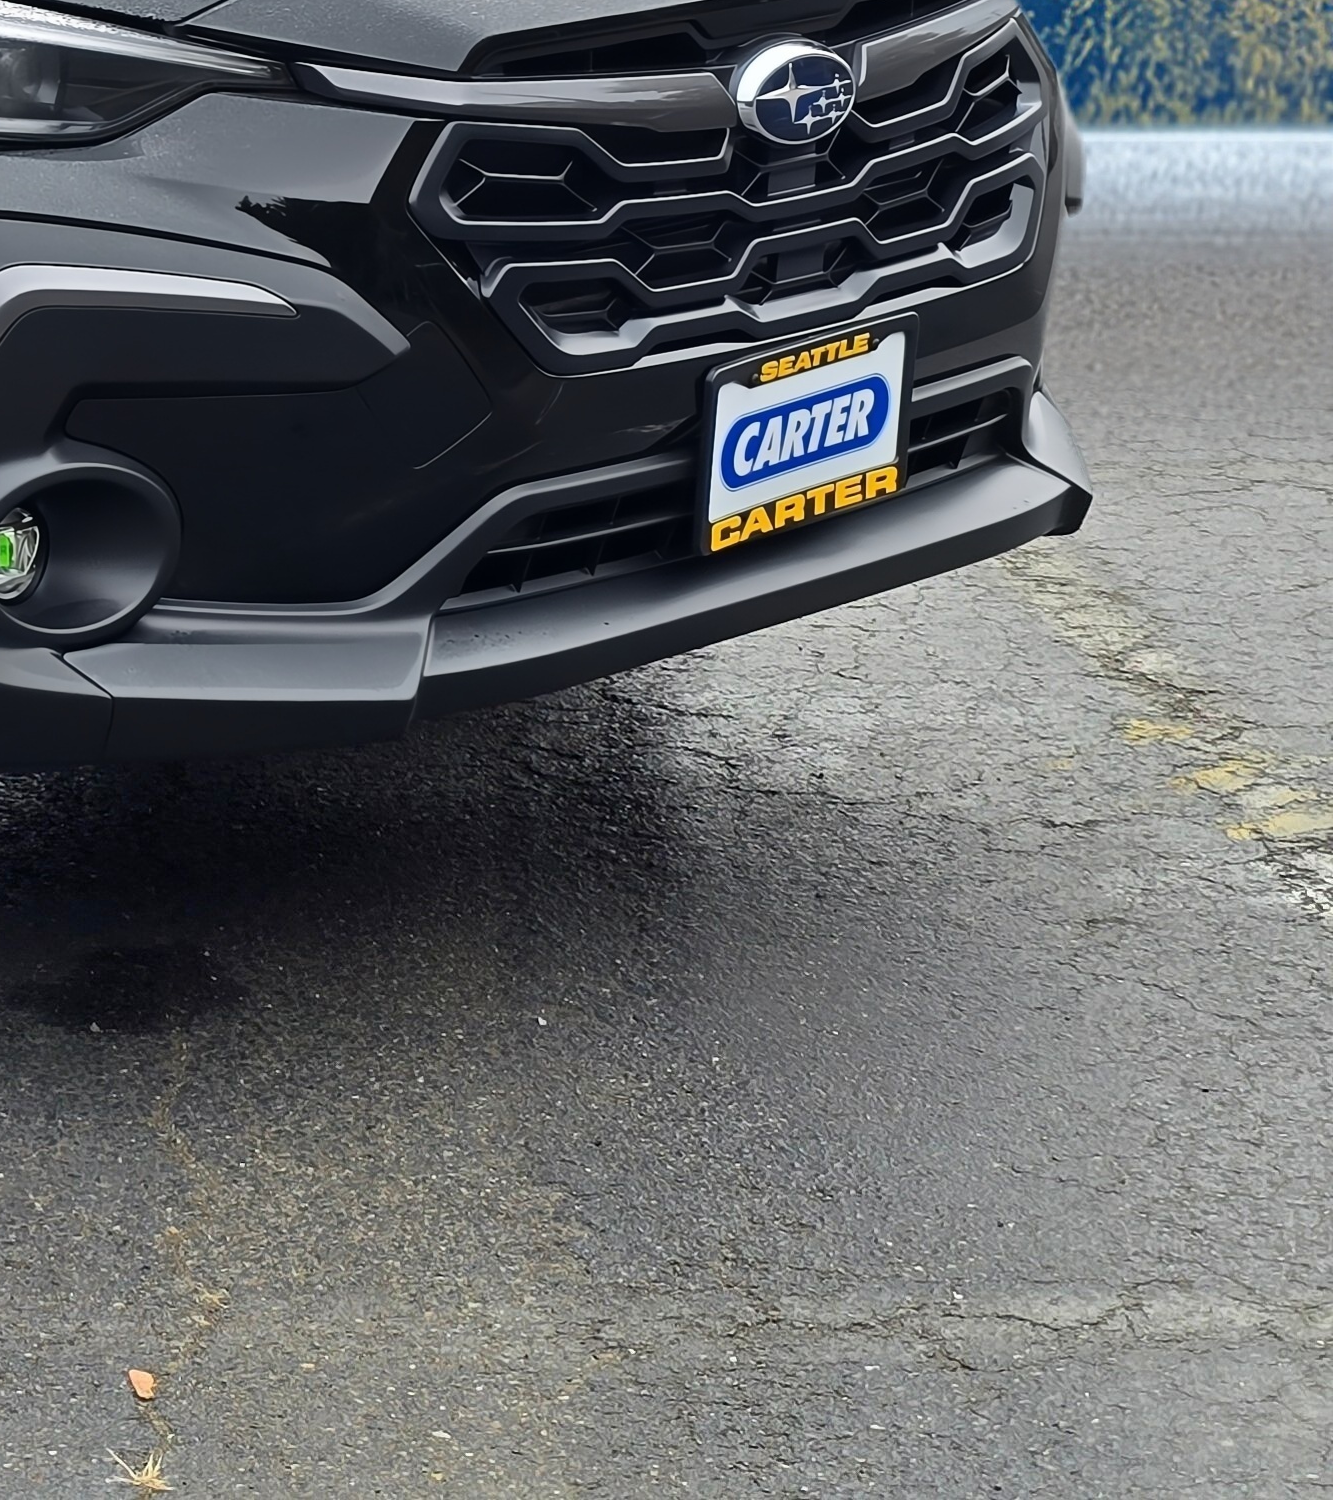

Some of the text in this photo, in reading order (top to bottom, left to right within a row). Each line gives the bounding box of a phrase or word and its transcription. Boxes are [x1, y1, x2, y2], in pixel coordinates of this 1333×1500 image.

[759, 332, 871, 383] SEATTLE
[733, 388, 875, 477] CARTER
[709, 465, 899, 553] CARTER
